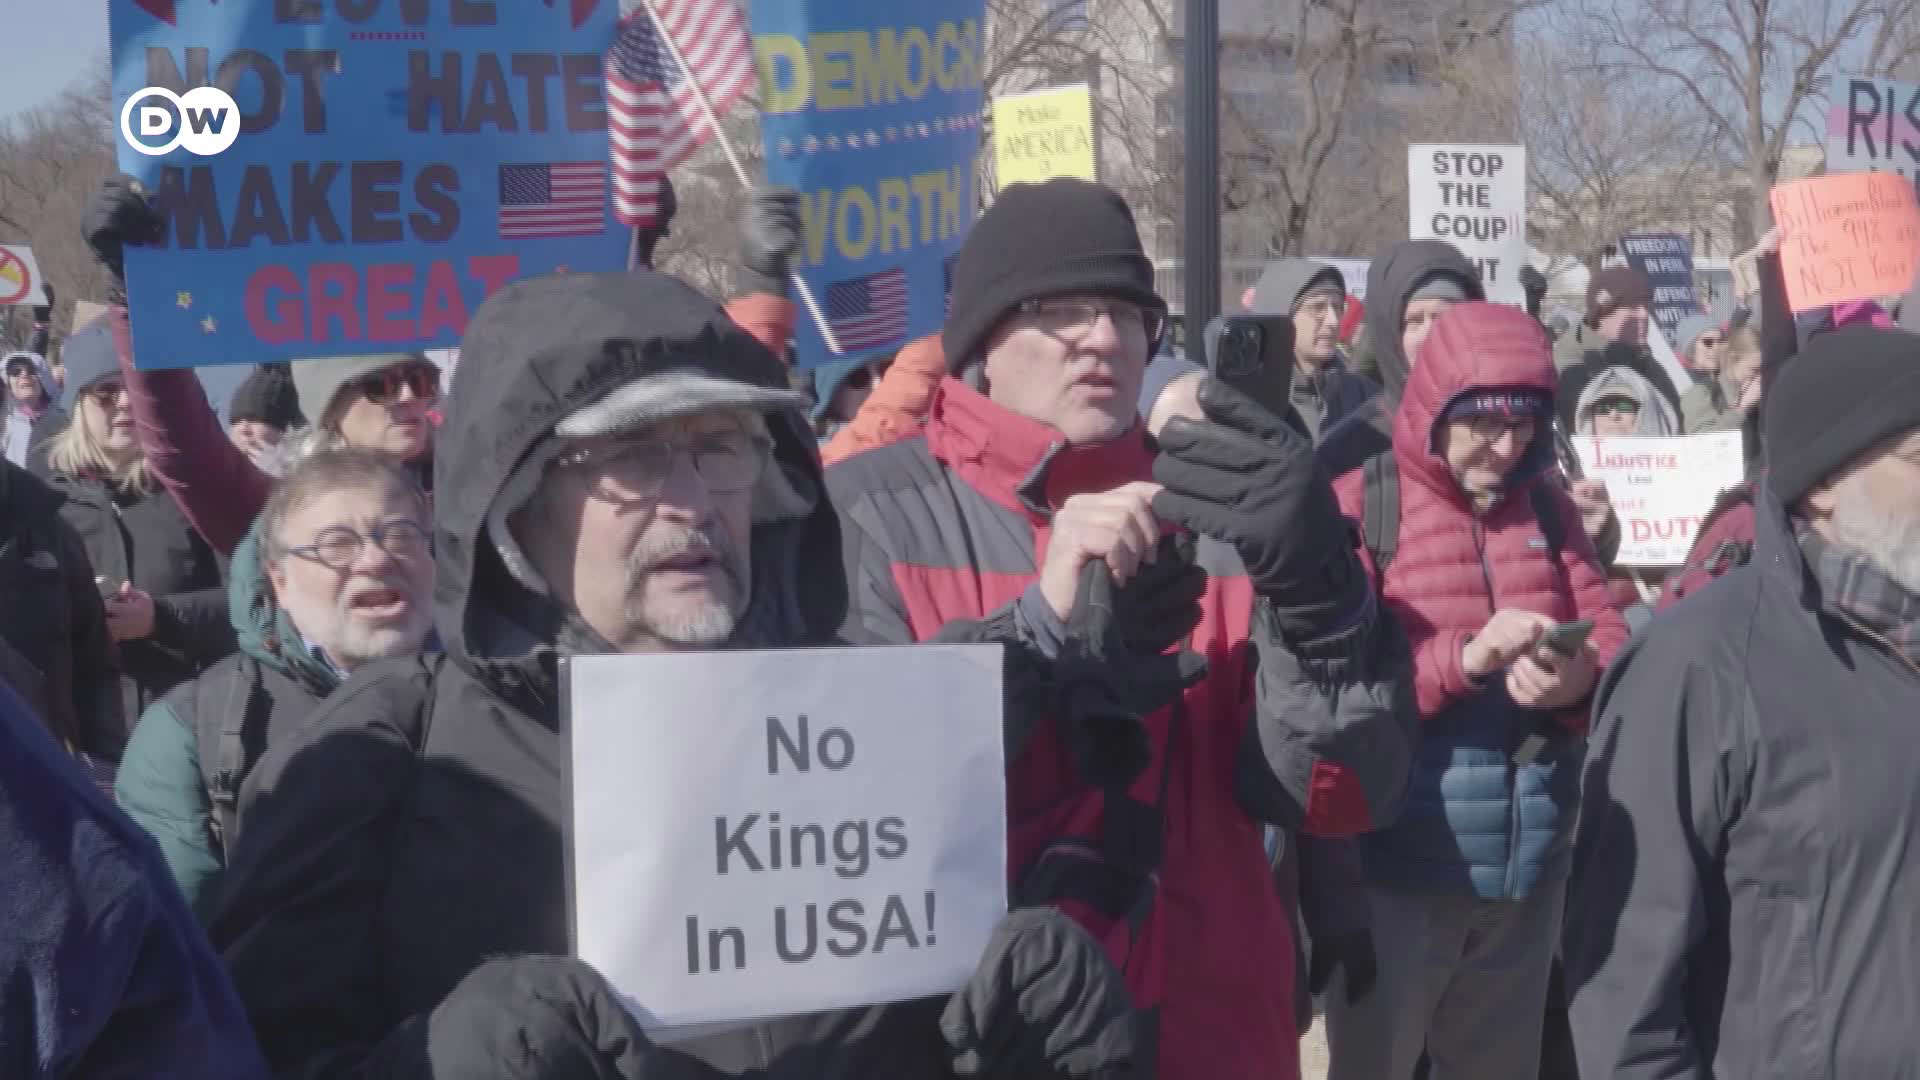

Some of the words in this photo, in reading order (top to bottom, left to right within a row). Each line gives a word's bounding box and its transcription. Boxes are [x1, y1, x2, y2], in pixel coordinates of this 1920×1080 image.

[407, 50, 605, 133] HATE
[1004, 125, 1090, 159] AMERICA
[1432, 151, 1503, 176] STOP
[158, 161, 461, 249] MAKES
[1437, 182, 1490, 207] THE
[1624, 239, 1681, 254] FREEDOM
[1799, 257, 1857, 296] NOT
[244, 255, 519, 345] GREAT
[766, 714, 856, 775] No
[714, 812, 909, 879] Kings
[686, 915, 746, 974] In
[774, 890, 936, 964] USA!
